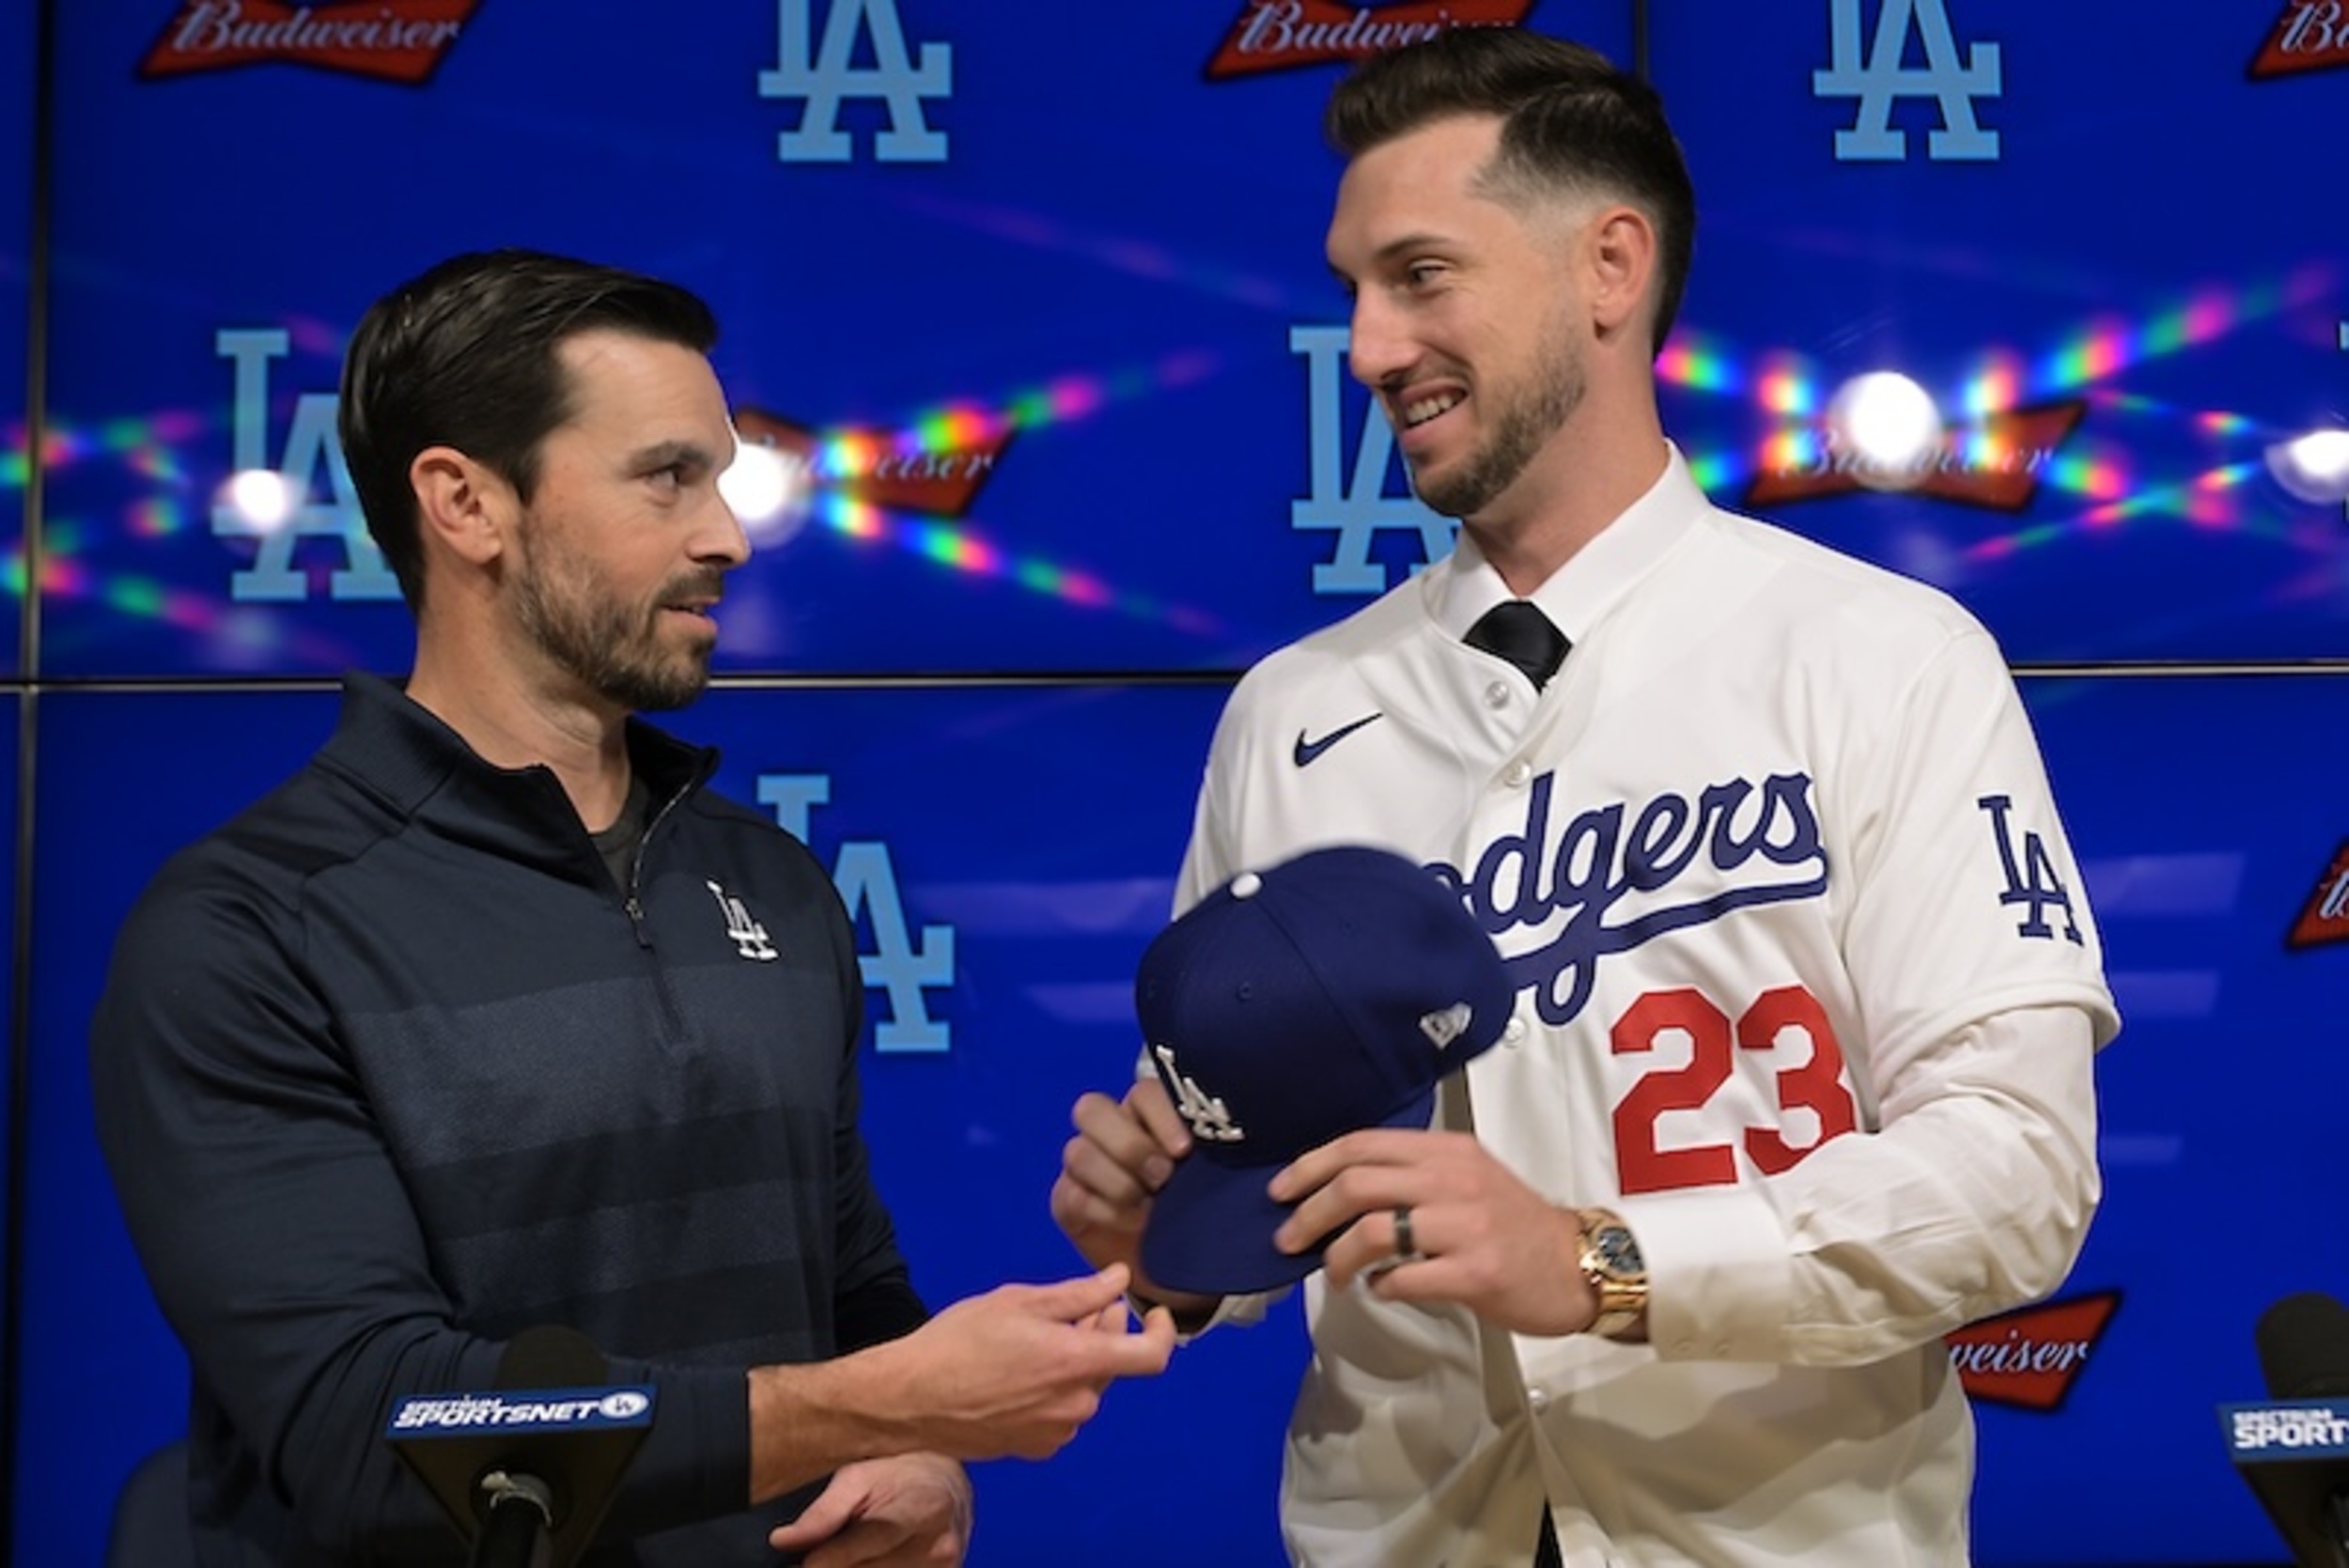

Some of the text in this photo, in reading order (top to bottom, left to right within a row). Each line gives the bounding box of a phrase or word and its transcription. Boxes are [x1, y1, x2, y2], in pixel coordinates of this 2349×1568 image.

[172, 0, 462, 51] Budweiser
[1238, 0, 1515, 53] Budwei
[1421, 769, 1827, 1026] dgers
[1977, 795, 2085, 947] LA
[707, 879, 779, 960] LA
[1156, 1044, 1245, 1141] LA
[1610, 985, 1859, 1195] 23
[394, 1400, 601, 1428] SPORTSNET
[2234, 1420, 2349, 1449] SPORT
